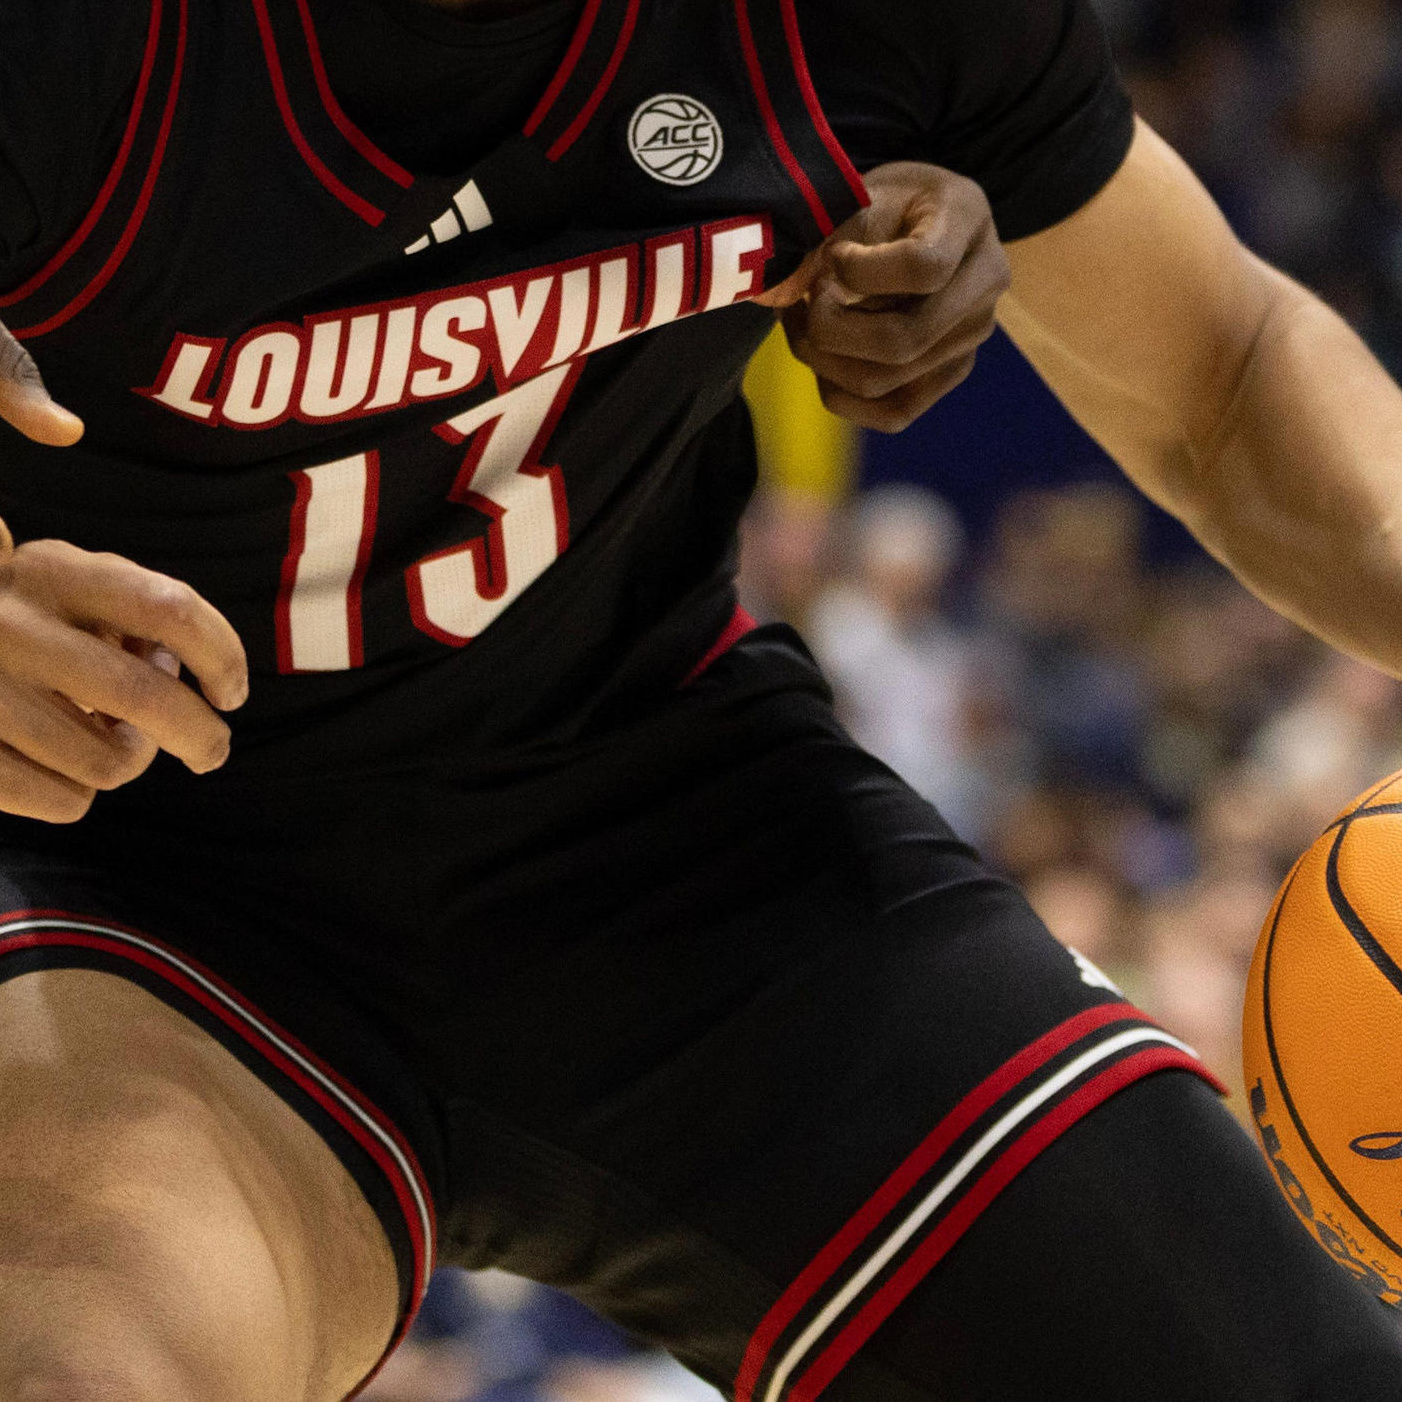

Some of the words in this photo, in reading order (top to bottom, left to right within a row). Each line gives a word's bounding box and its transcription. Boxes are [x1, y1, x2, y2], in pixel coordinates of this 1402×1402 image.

[643, 122, 712, 147] ACC
[132, 214, 775, 429] LOUISVILLE
[275, 360, 569, 675] 13
